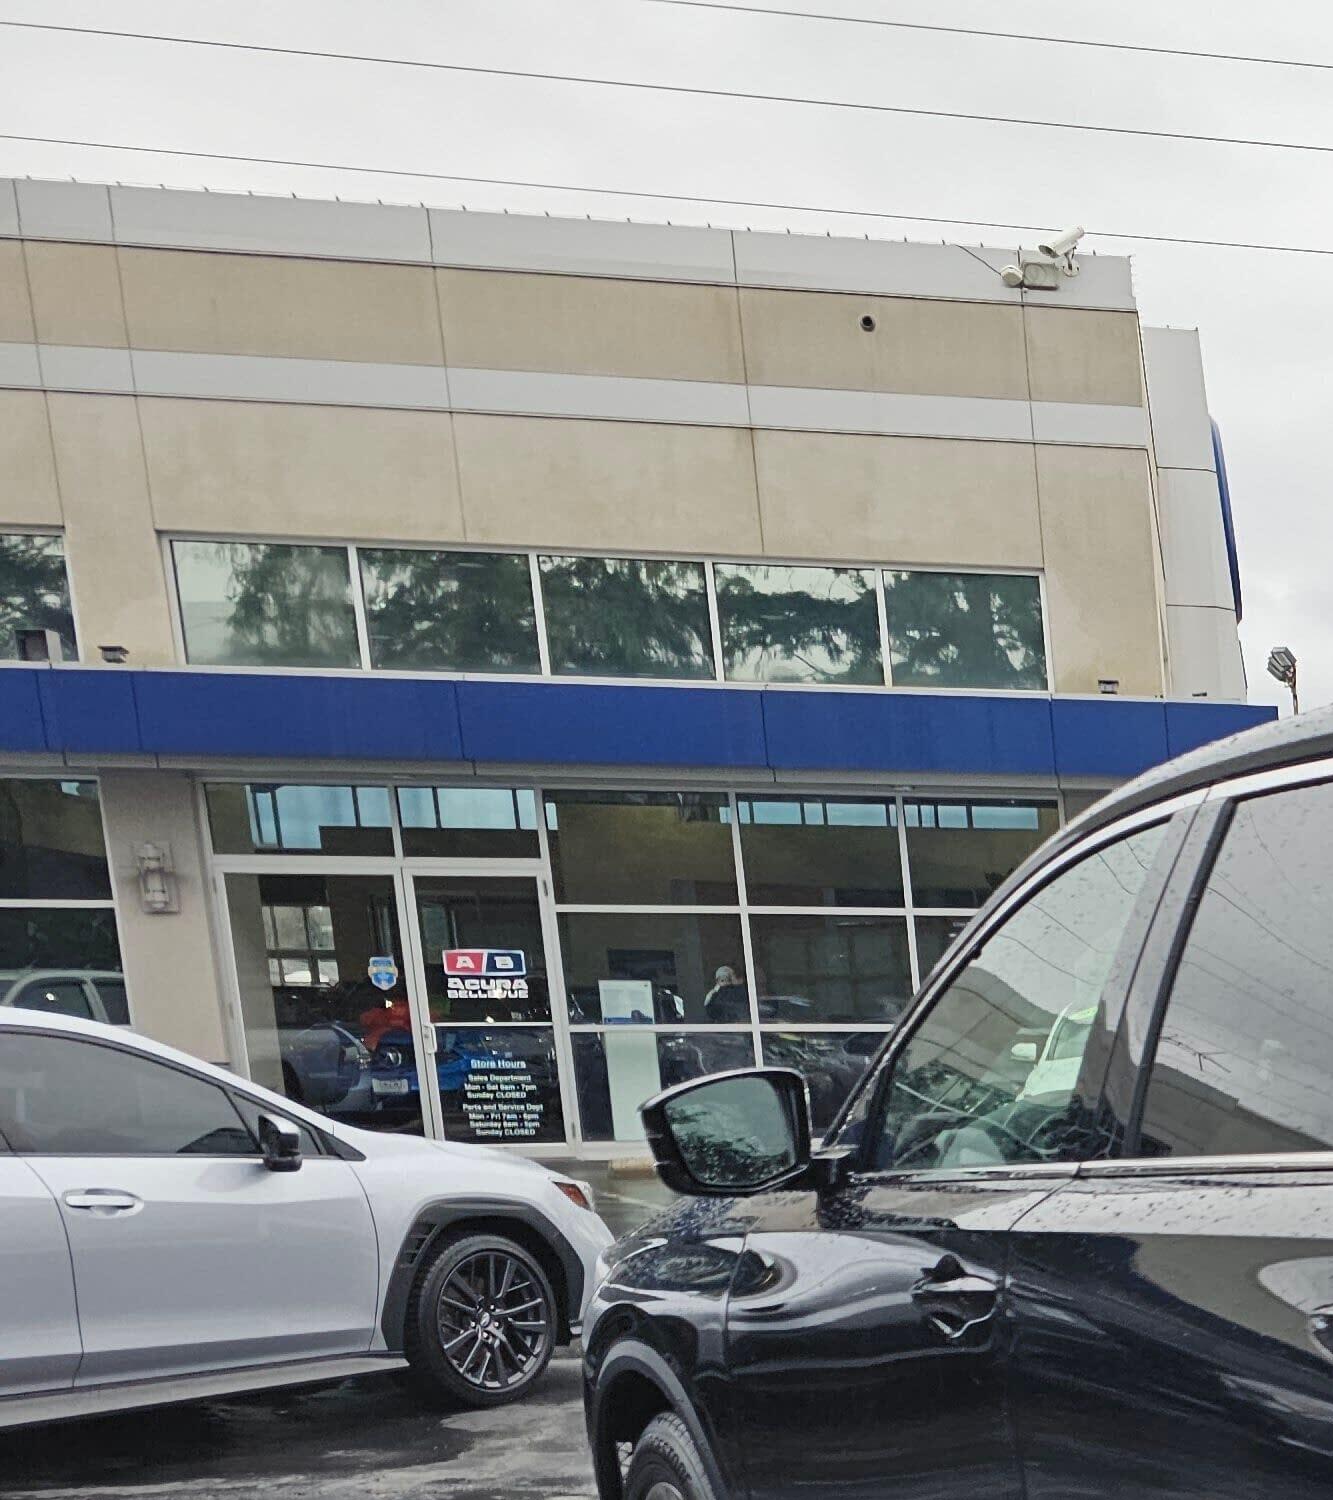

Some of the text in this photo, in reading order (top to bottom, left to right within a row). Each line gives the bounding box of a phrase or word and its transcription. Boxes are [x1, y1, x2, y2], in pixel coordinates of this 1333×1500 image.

[456, 956, 475, 968] A
[447, 978, 528, 990] ACURA
[447, 990, 528, 999] BELLEVUE
[470, 1059, 526, 1069] Store Hours
[468, 1074, 532, 1082] Sales Department
[464, 1083, 481, 1091] Mon
[467, 1091, 527, 1100] Sunday CLOSED
[463, 1104, 482, 1112] Parts
[498, 1104, 525, 1112] Service
[470, 1121, 502, 1129] Saturday
[476, 1129, 536, 1138] Sunday CLOSED
